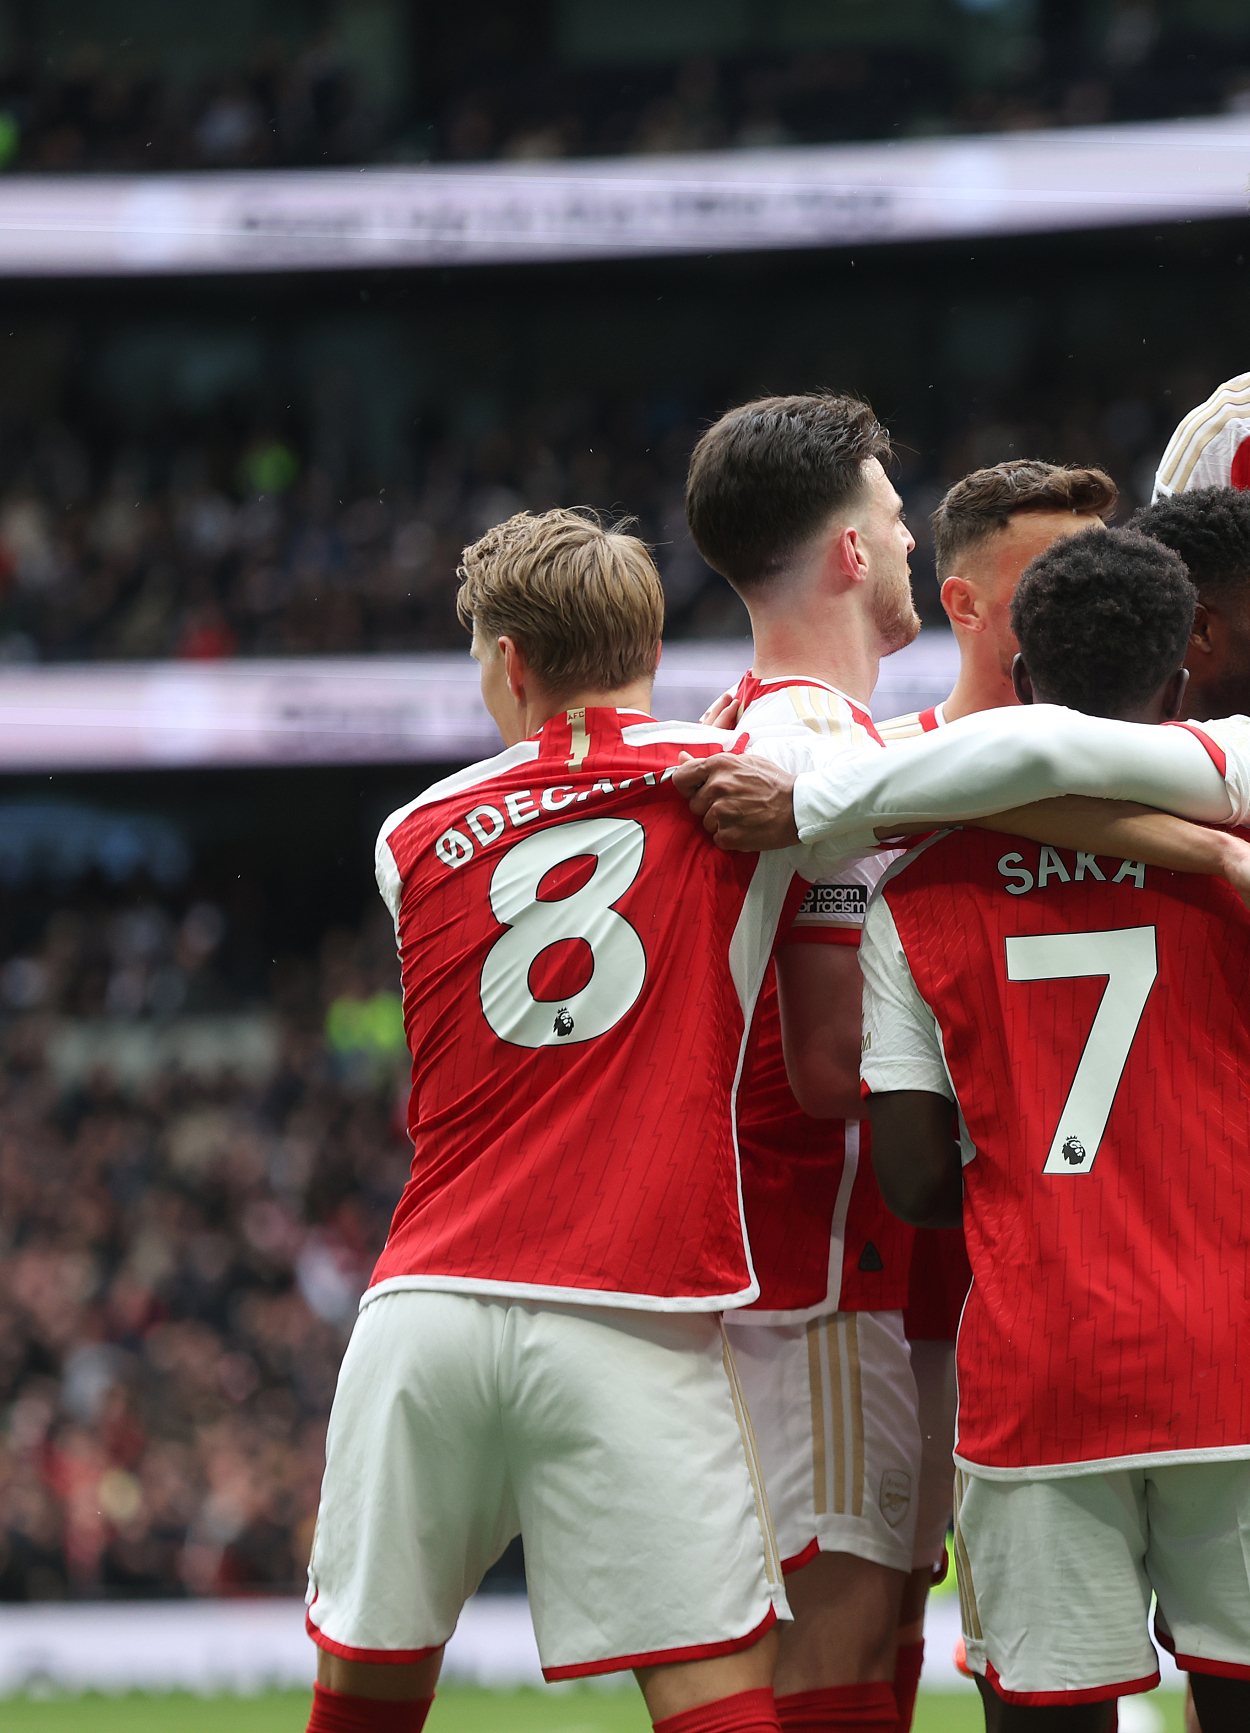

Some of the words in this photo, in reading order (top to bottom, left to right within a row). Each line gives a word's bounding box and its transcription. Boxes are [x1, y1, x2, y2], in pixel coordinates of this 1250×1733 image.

[567, 710, 586, 721] AFC
[997, 846, 1147, 896] SAKA
[816, 901, 866, 913] racism
[817, 888, 860, 900] room
[479, 817, 647, 1049] 8
[1004, 924, 1158, 1175] 7
